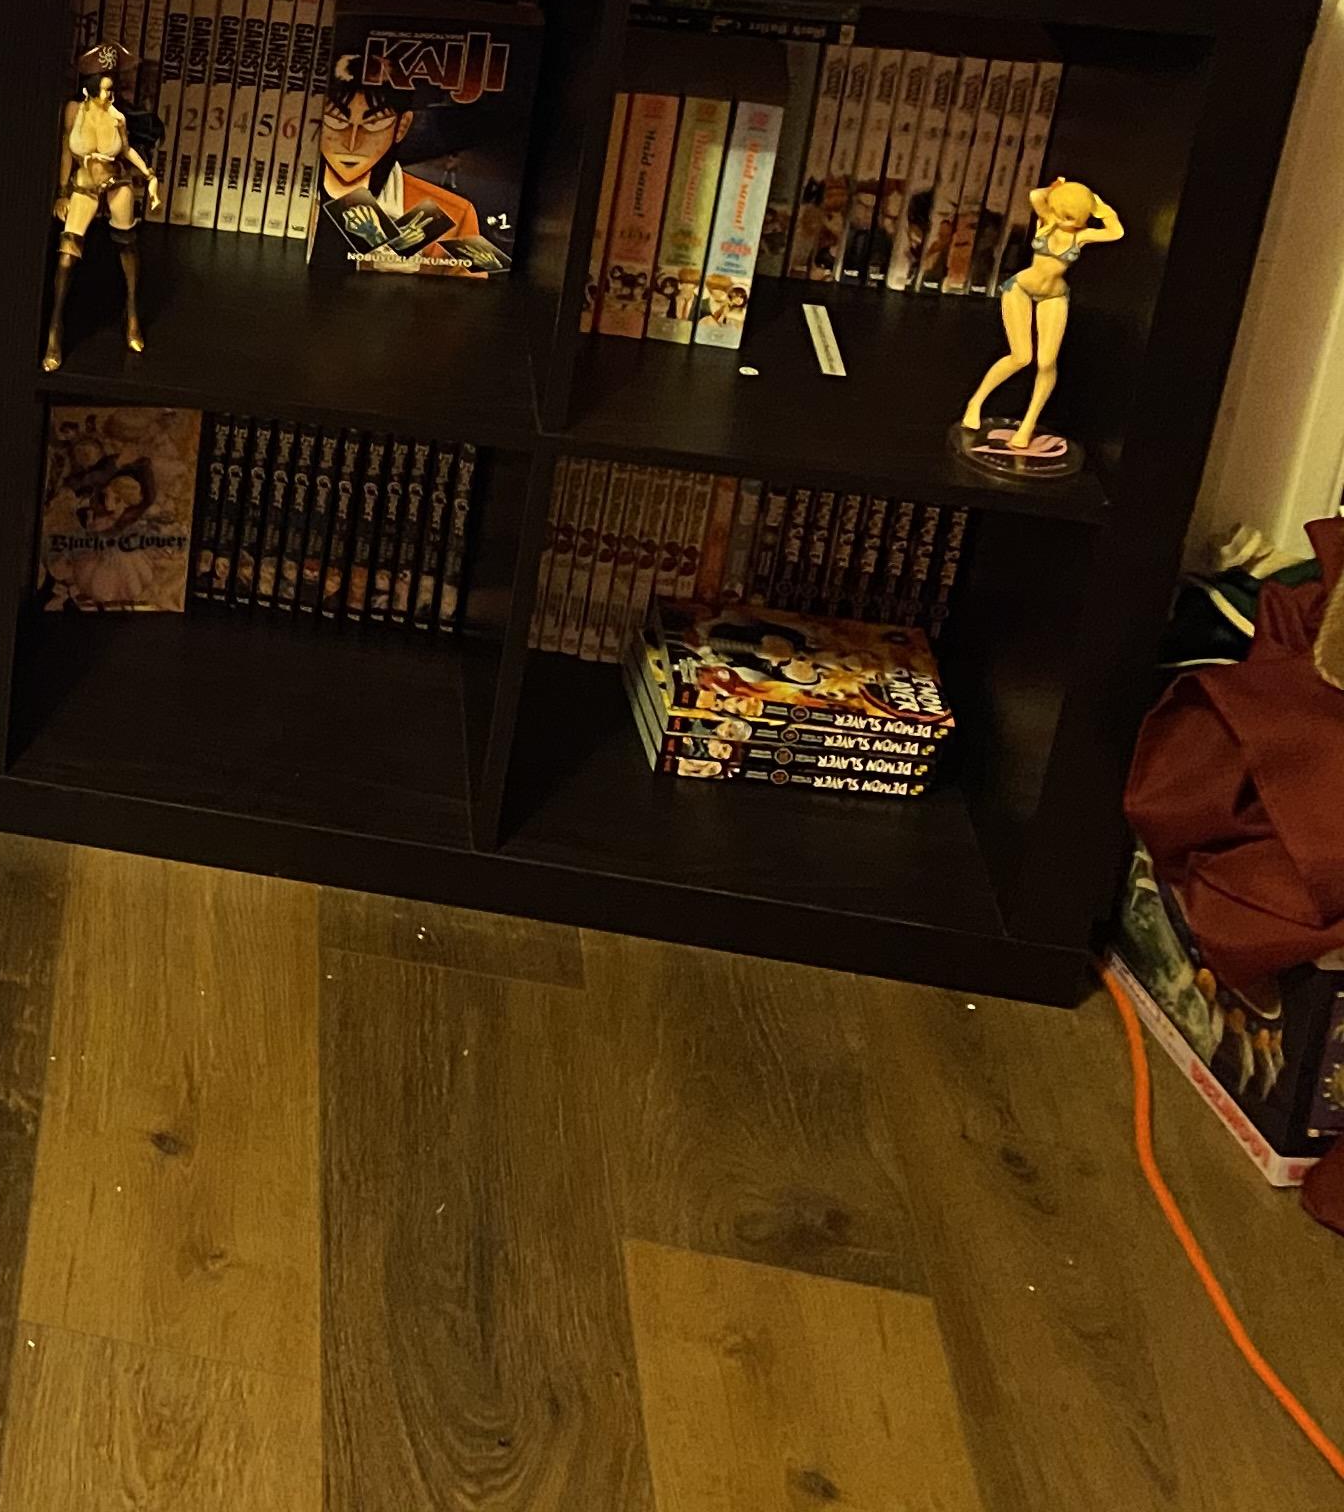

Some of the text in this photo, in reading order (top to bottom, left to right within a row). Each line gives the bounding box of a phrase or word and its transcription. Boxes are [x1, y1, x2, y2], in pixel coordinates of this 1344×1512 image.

[362, 31, 510, 104] KAIJI
[184, 107, 200, 131] 2
[208, 107, 224, 131] 3
[233, 111, 250, 134] 4
[257, 114, 275, 137] 5
[282, 117, 298, 139] 6
[309, 119, 321, 142] 7
[487, 213, 512, 230] #1
[834, 714, 933, 738] DEMON SLAYER
[823, 735, 920, 756] DEMON SLAYER
[817, 754, 912, 776] DEMON SLAYER
[813, 775, 908, 796] DEMON SLAYER
